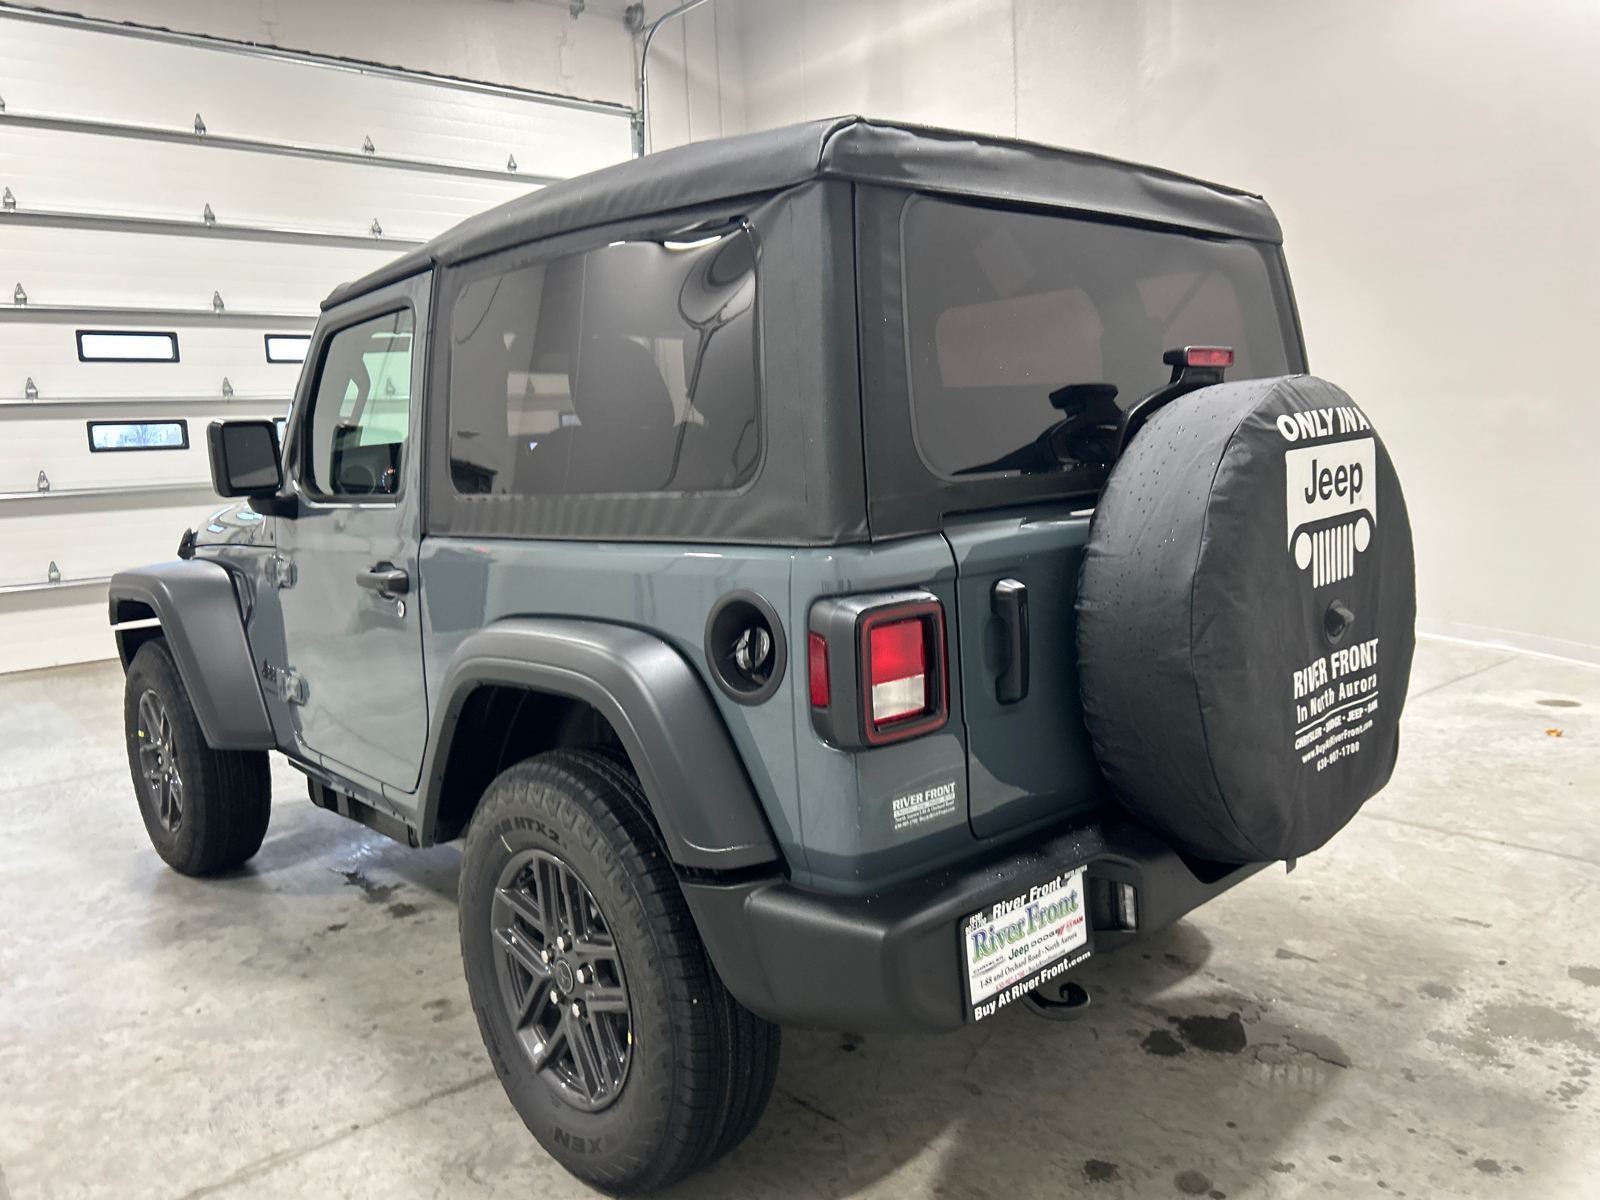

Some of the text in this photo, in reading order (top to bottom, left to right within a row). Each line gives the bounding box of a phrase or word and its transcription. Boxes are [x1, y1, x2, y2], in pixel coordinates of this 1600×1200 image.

[1276, 406, 1371, 442] ONLY IN A
[1304, 459, 1363, 504] Jeep
[1293, 638, 1379, 700] RIVER FRONT
[1296, 673, 1377, 724] In North Aurora
[1347, 707, 1364, 722] JEEP
[893, 793, 924, 811] RIVER
[925, 782, 956, 801] FRONT
[993, 876, 1062, 919] River Front
[971, 918, 1026, 964] River
[1025, 889, 1079, 935] Front
[1008, 943, 1030, 961] Jeep
[974, 999, 996, 1021] Buy
[998, 990, 1011, 1008] At
[1011, 975, 1039, 1000] River
[1041, 951, 1091, 984] Front.com
